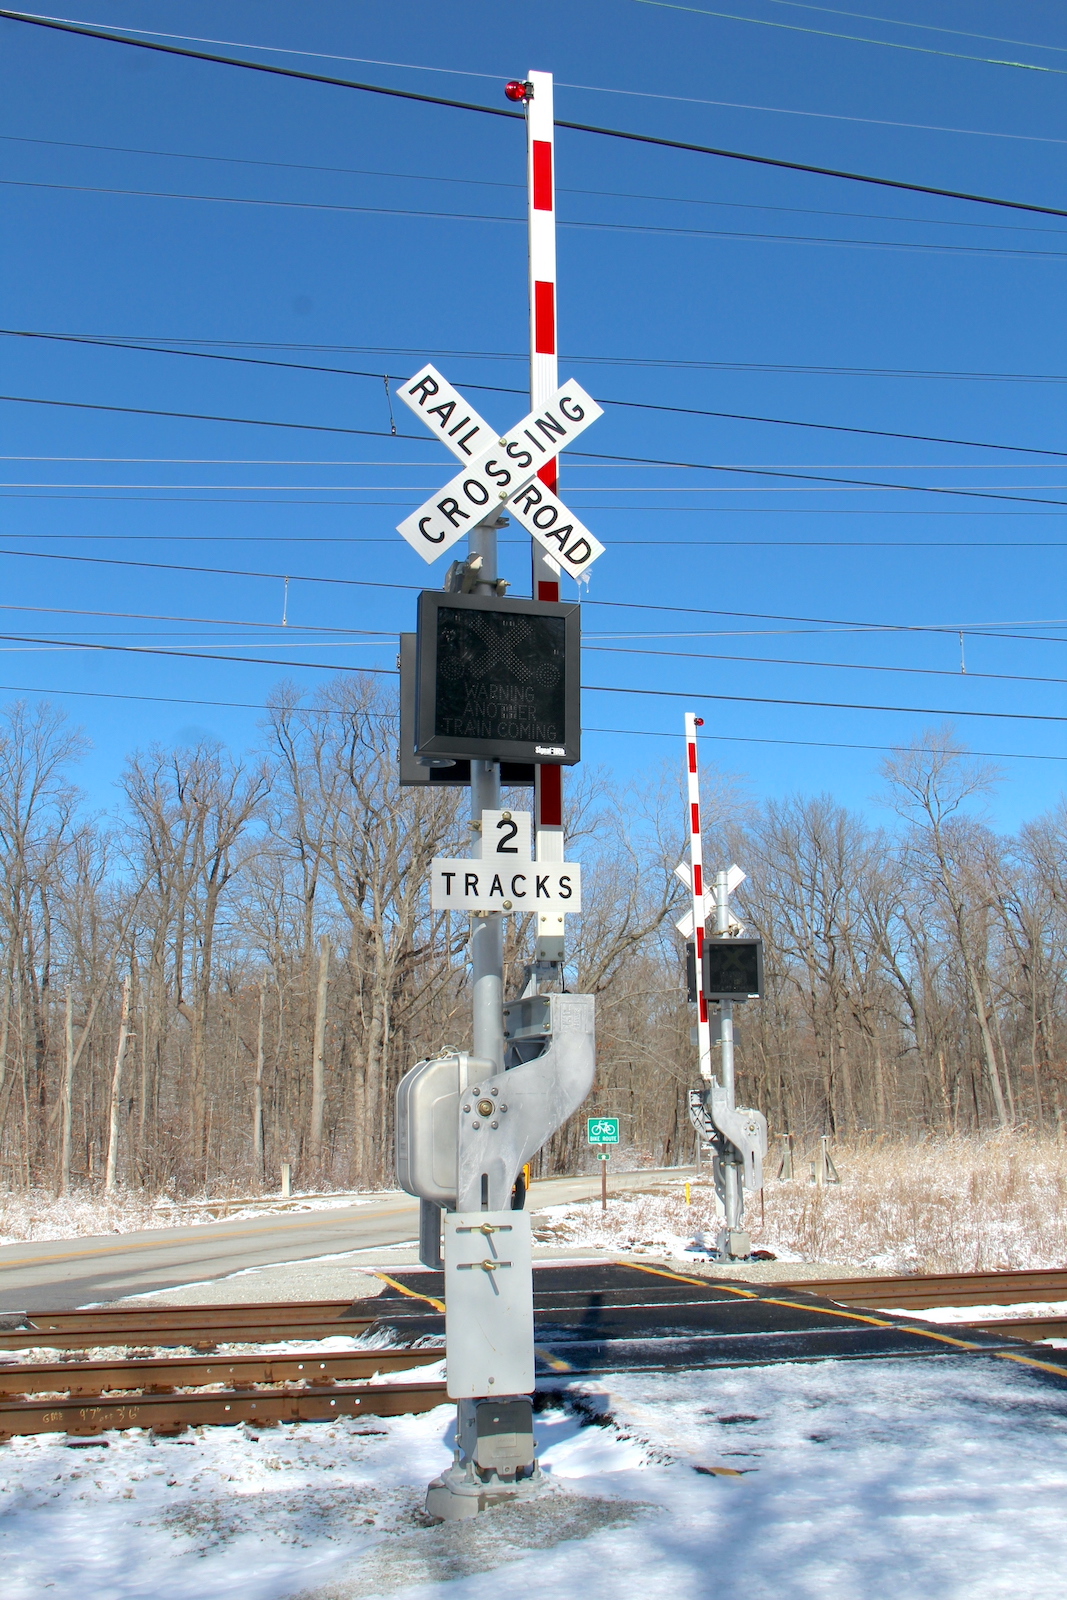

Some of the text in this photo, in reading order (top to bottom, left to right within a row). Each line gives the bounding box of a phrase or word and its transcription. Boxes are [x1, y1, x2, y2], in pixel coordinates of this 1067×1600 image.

[408, 375, 480, 456] RAIL
[418, 396, 585, 544] CROSSING
[512, 484, 592, 565] ROAD
[464, 681, 535, 701] WARNING
[463, 700, 537, 721] ANOTHER
[442, 717, 557, 741] TRAIN COMING
[496, 819, 518, 853] 2
[441, 872, 573, 899] TRACKS
